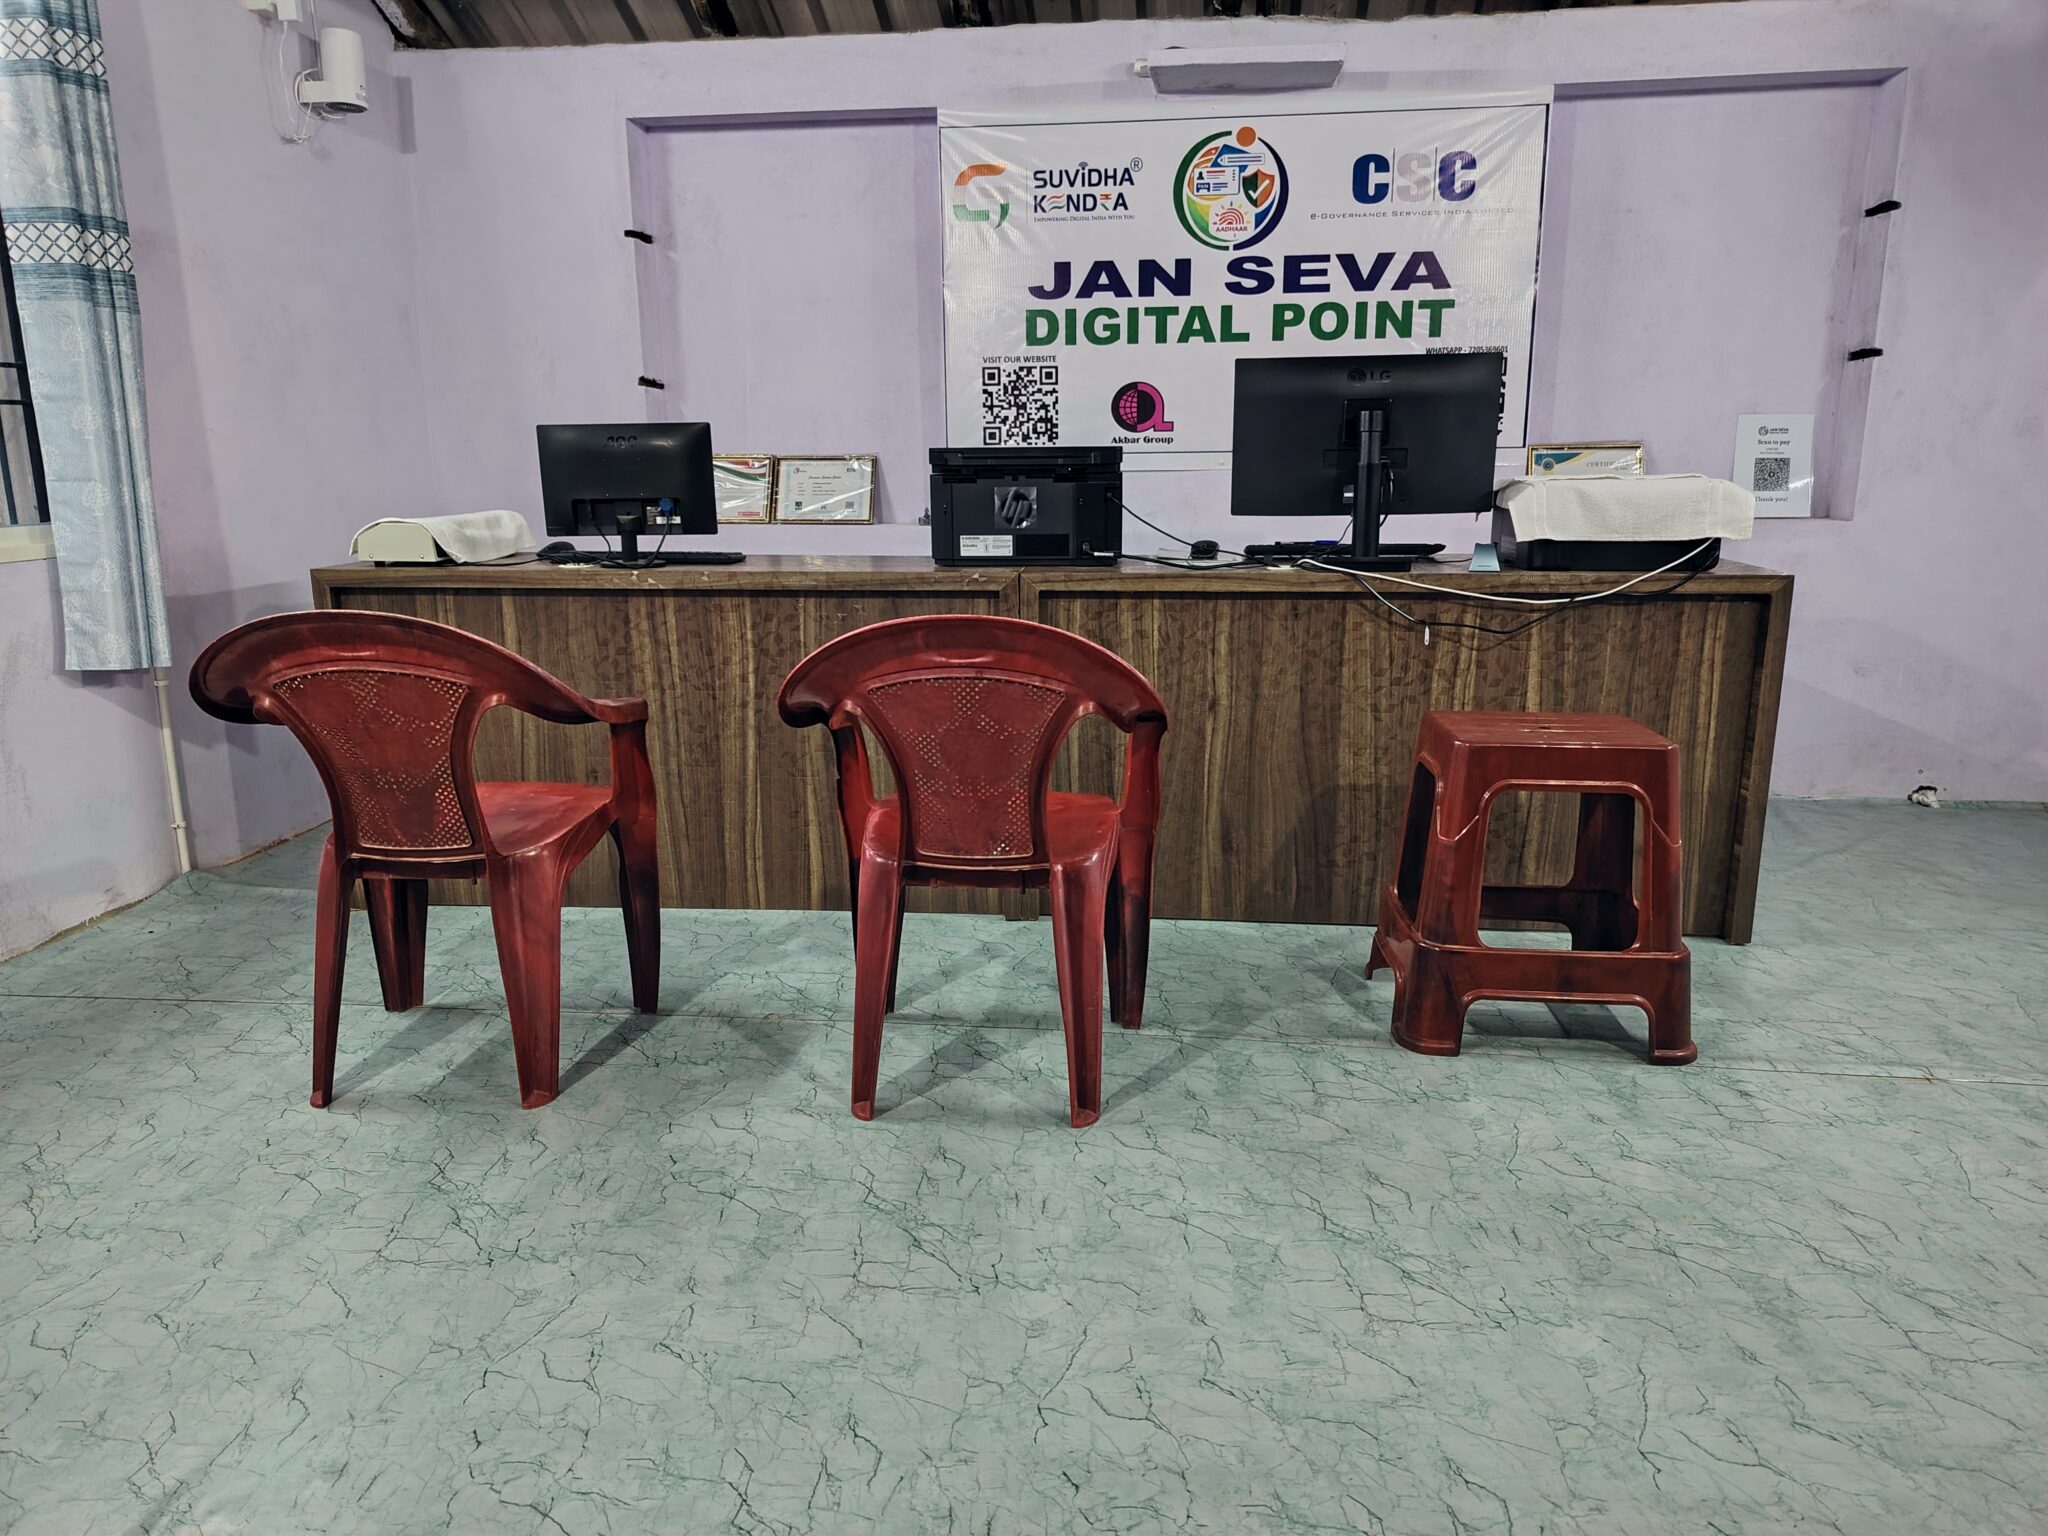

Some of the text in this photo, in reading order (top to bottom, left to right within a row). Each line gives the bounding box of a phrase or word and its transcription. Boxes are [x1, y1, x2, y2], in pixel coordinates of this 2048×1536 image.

[1352, 150, 1477, 204] CSC
[1033, 192, 1129, 213] KENDRA
[1028, 251, 1453, 300] JAN SEVA
[1025, 298, 1456, 347] DIGITAL POINT
[1425, 346, 1463, 355] WHATSAPP
[982, 355, 1057, 364] VISIT OUR WEBSITE
[1370, 370, 1392, 383] LG
[1111, 434, 1174, 445] Akbar Group
